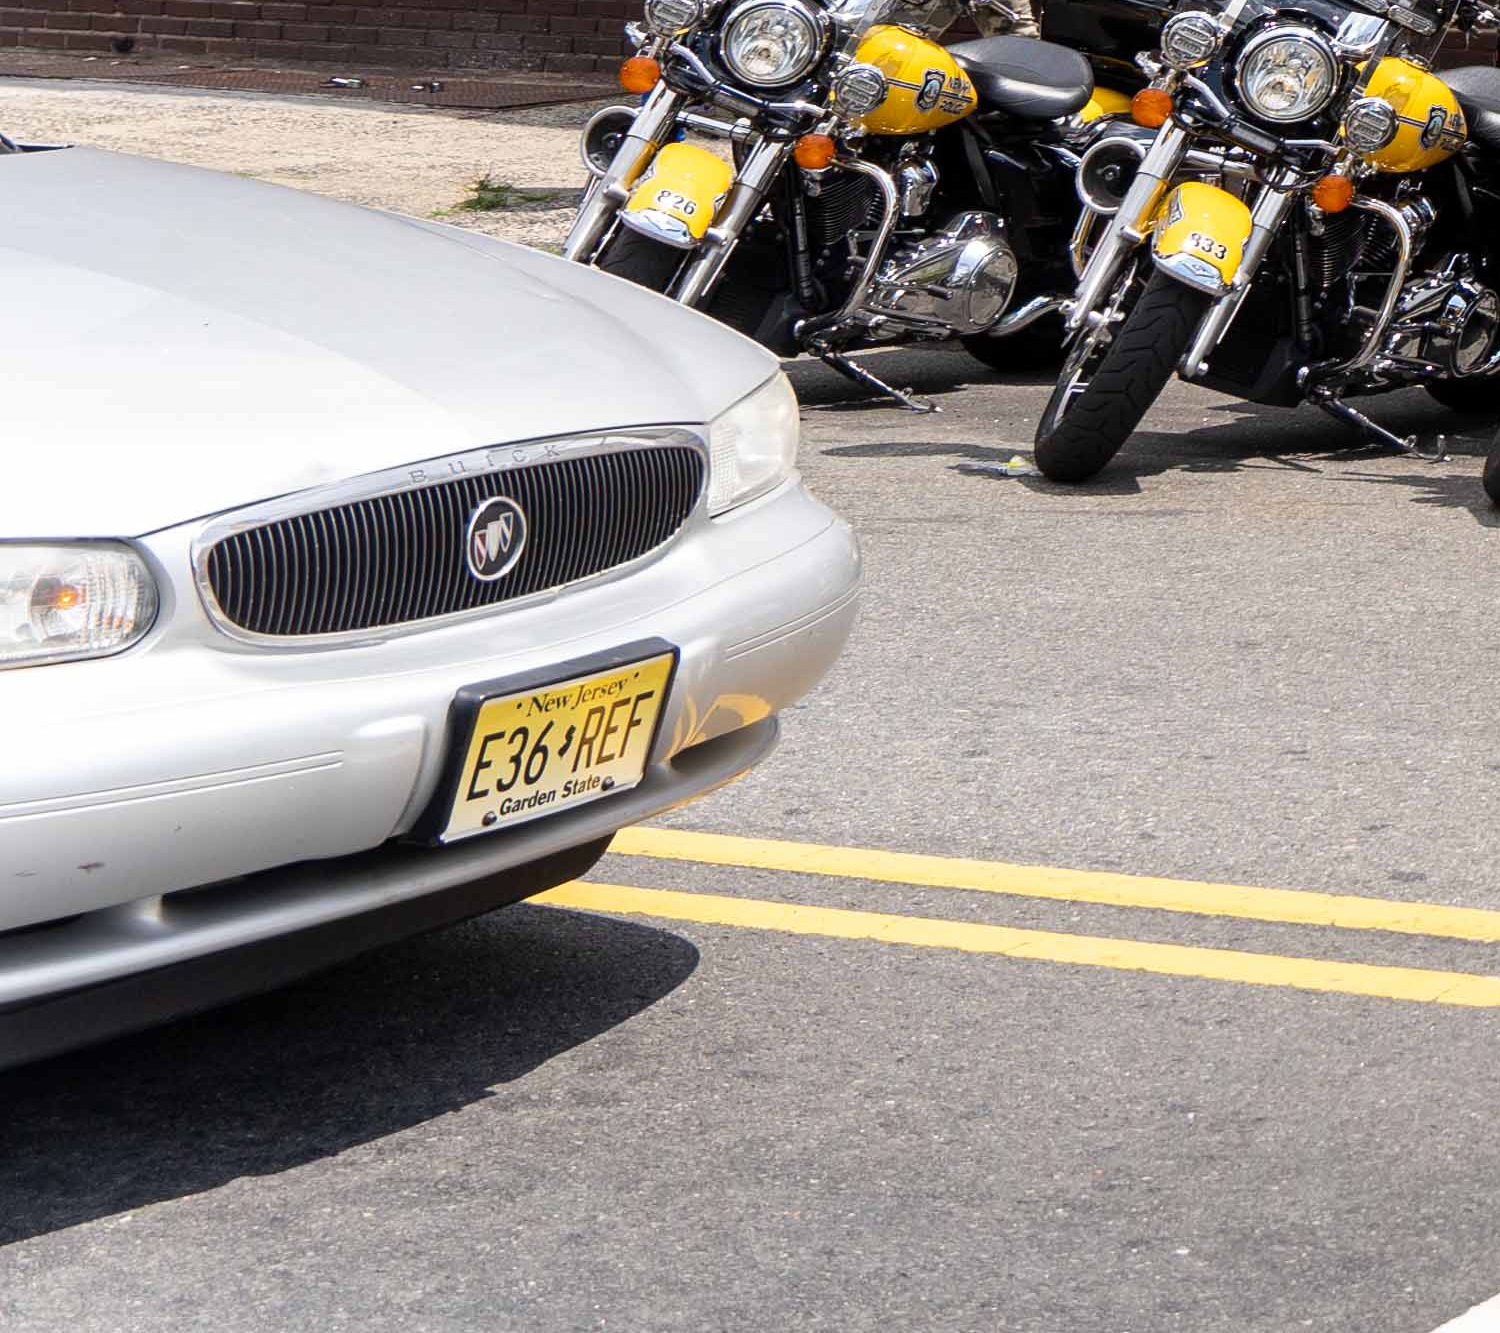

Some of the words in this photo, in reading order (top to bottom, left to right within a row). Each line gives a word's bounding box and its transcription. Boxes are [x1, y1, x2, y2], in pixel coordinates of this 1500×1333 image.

[656, 190, 697, 215] 826
[525, 690, 571, 718] New
[571, 674, 629, 713] Jersey
[465, 719, 555, 802] E36
[571, 690, 655, 773] REF
[499, 788, 556, 817] Garden
[560, 774, 602, 800] State
